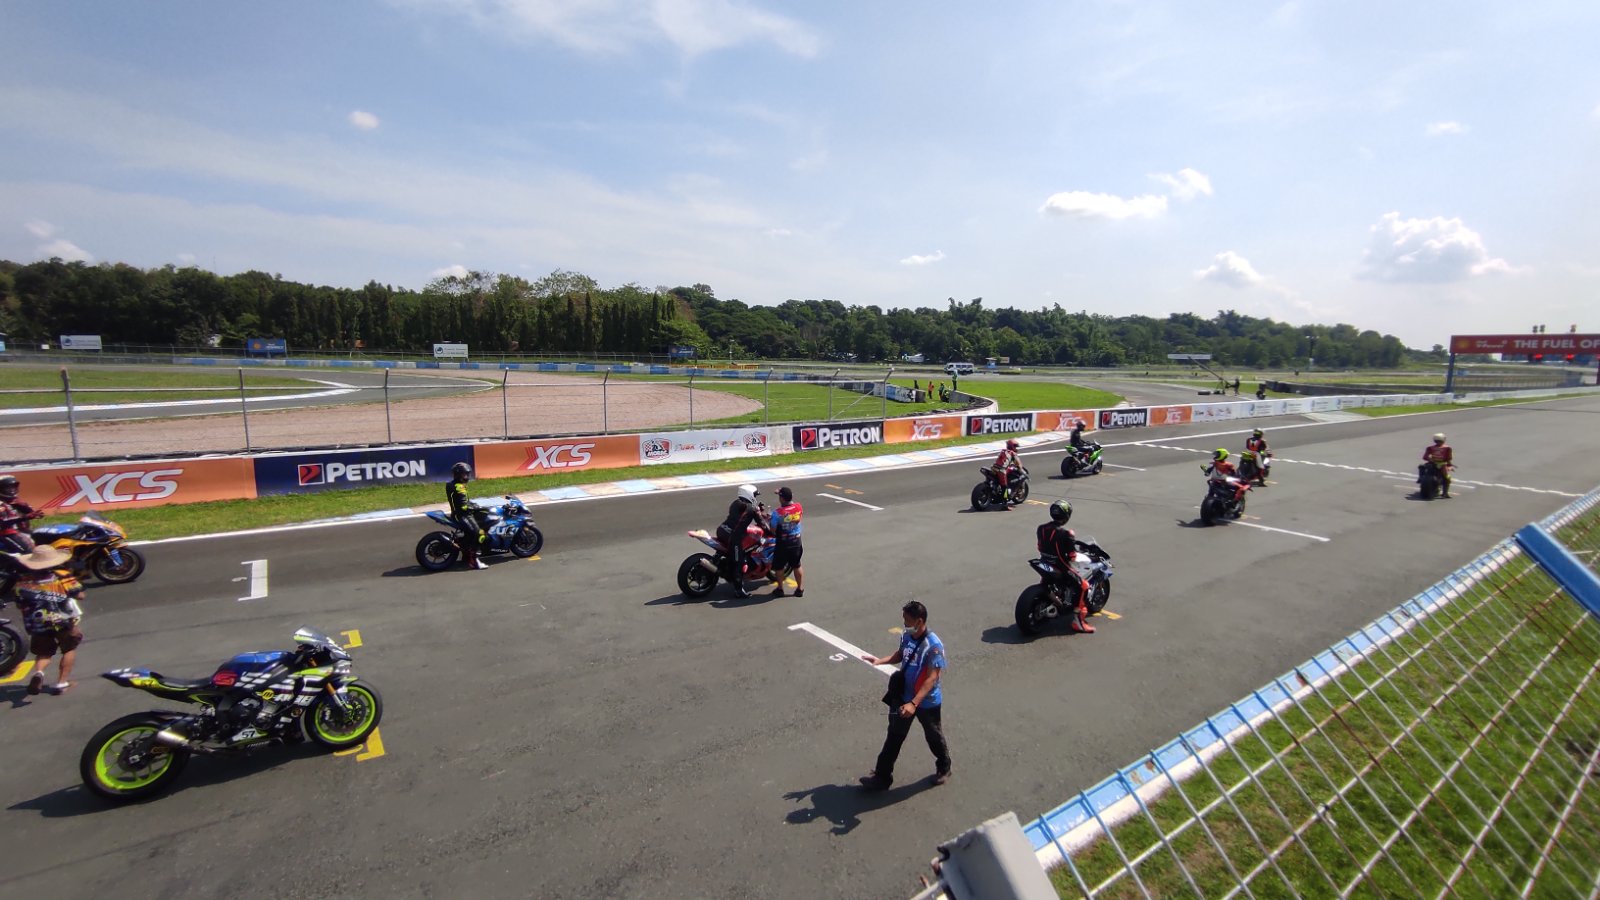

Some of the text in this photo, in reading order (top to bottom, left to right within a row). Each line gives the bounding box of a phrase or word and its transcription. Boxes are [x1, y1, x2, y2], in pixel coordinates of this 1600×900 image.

[1514, 339, 1538, 348] THE
[1542, 339, 1576, 348] FUEL
[983, 418, 1028, 433] PETRON
[1111, 412, 1145, 426] PETRON
[818, 427, 880, 447] PETRON
[911, 424, 943, 441] XCS
[527, 443, 596, 470] XCS
[326, 460, 426, 482] PETRON
[60, 468, 184, 507] XCS
[241, 730, 256, 738] 57
